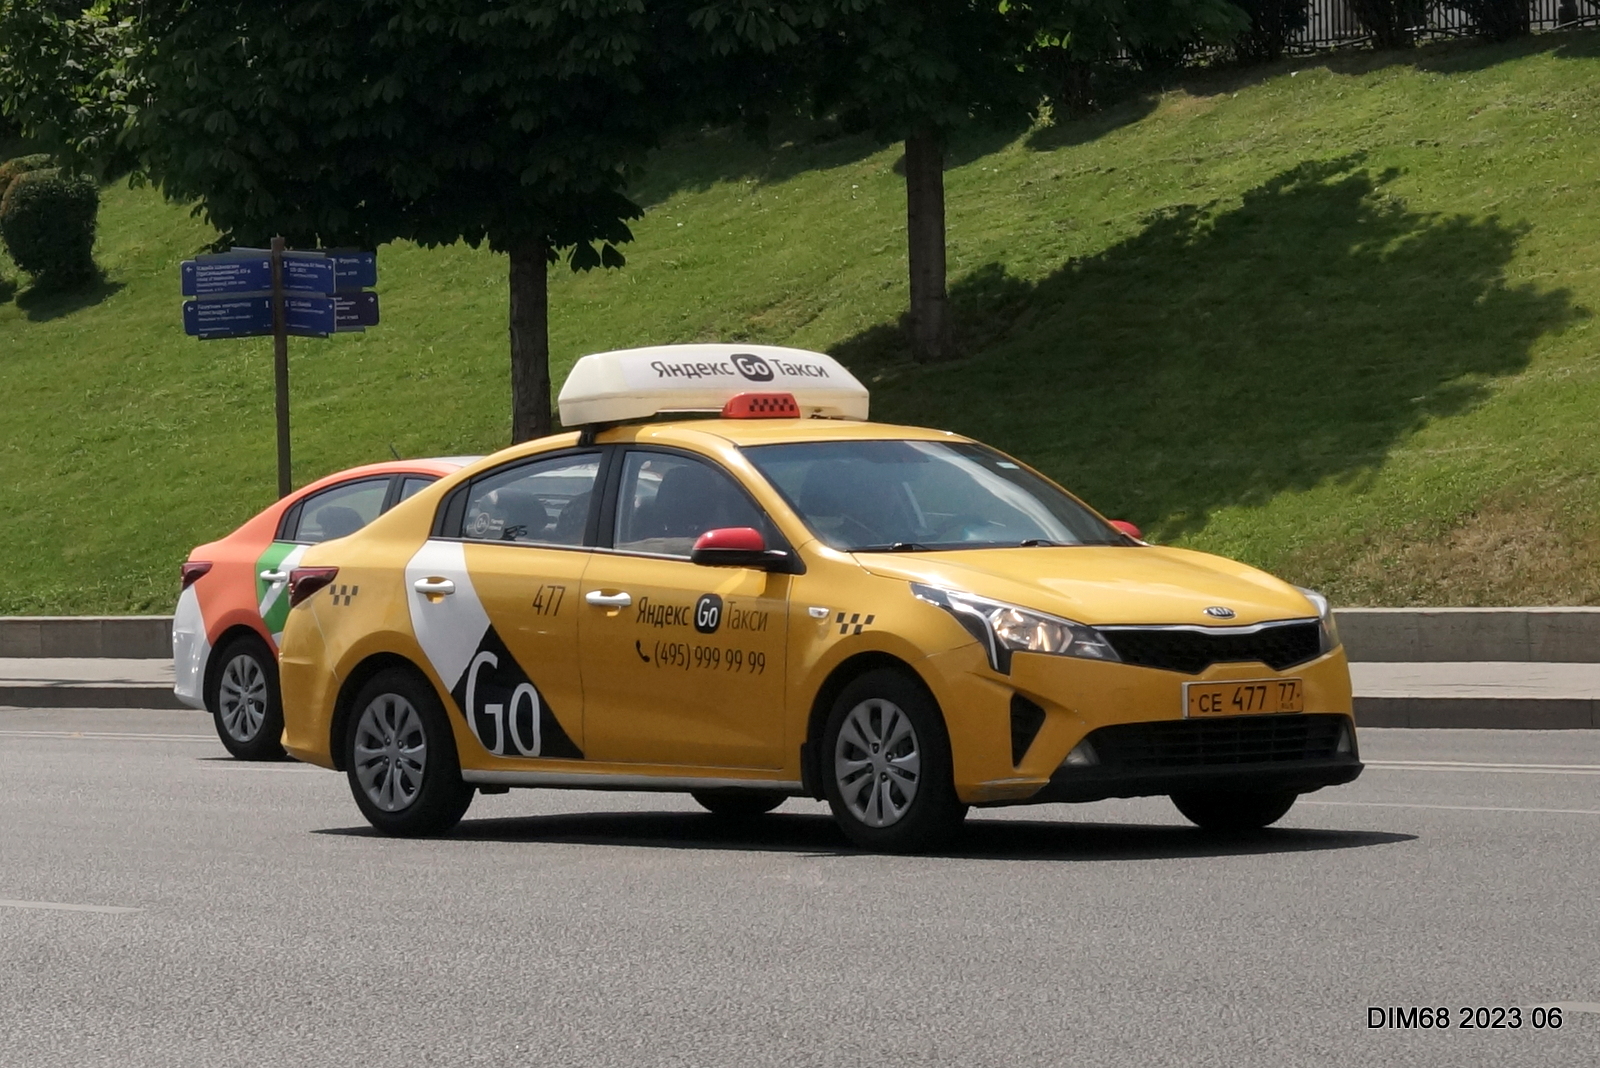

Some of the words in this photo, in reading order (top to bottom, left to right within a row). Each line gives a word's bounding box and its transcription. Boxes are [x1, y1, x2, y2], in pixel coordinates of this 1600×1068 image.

[650, 360, 735, 379] Яндекс
[736, 357, 769, 376] Go
[769, 358, 830, 378] Такси
[532, 584, 566, 617] 477
[636, 596, 690, 627] Яндекс
[697, 598, 718, 627] Go
[726, 601, 769, 632] Такси
[1208, 606, 1234, 617] KIA
[654, 640, 690, 671] (495)
[694, 645, 720, 670] 999
[725, 647, 742, 673] 99
[748, 650, 766, 675] 99
[1232, 685, 1267, 711] 477
[1278, 682, 1296, 702] 77
